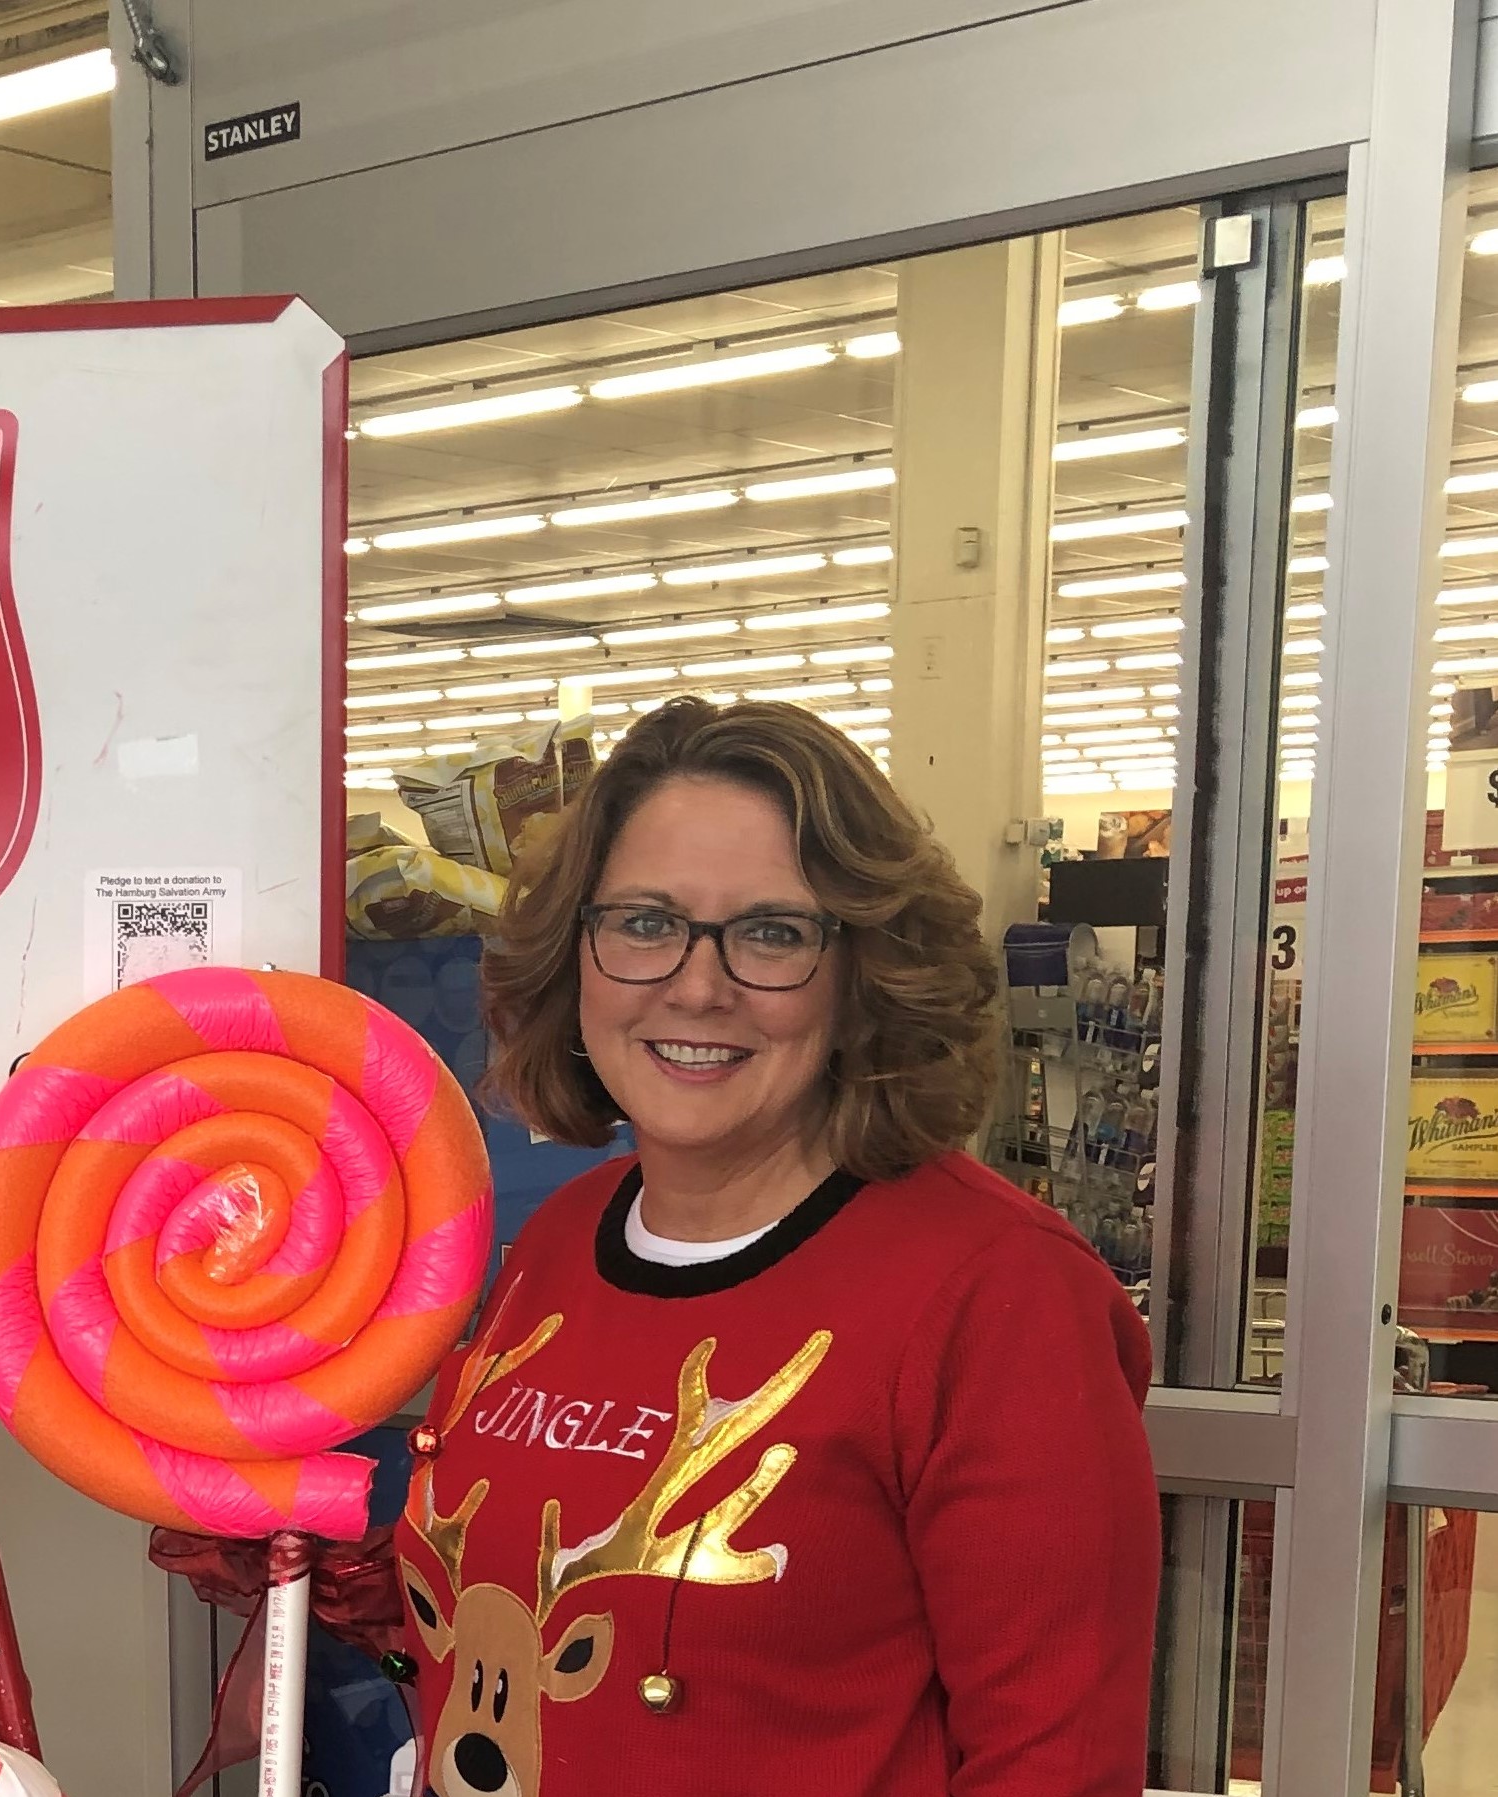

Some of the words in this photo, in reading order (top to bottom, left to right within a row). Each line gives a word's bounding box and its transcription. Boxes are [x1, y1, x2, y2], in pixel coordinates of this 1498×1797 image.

[207, 111, 296, 152] STANLEY
[96, 888, 113, 897] The
[116, 888, 157, 898] Hamburg
[159, 887, 201, 897] Salvation
[202, 887, 227, 898] Army
[100, 876, 131, 886] Pledge
[134, 876, 143, 885] to
[144, 876, 162, 885] text
[172, 876, 210, 884] donation
[213, 875, 222, 884] to
[475, 1378, 673, 1461] JINGLE
